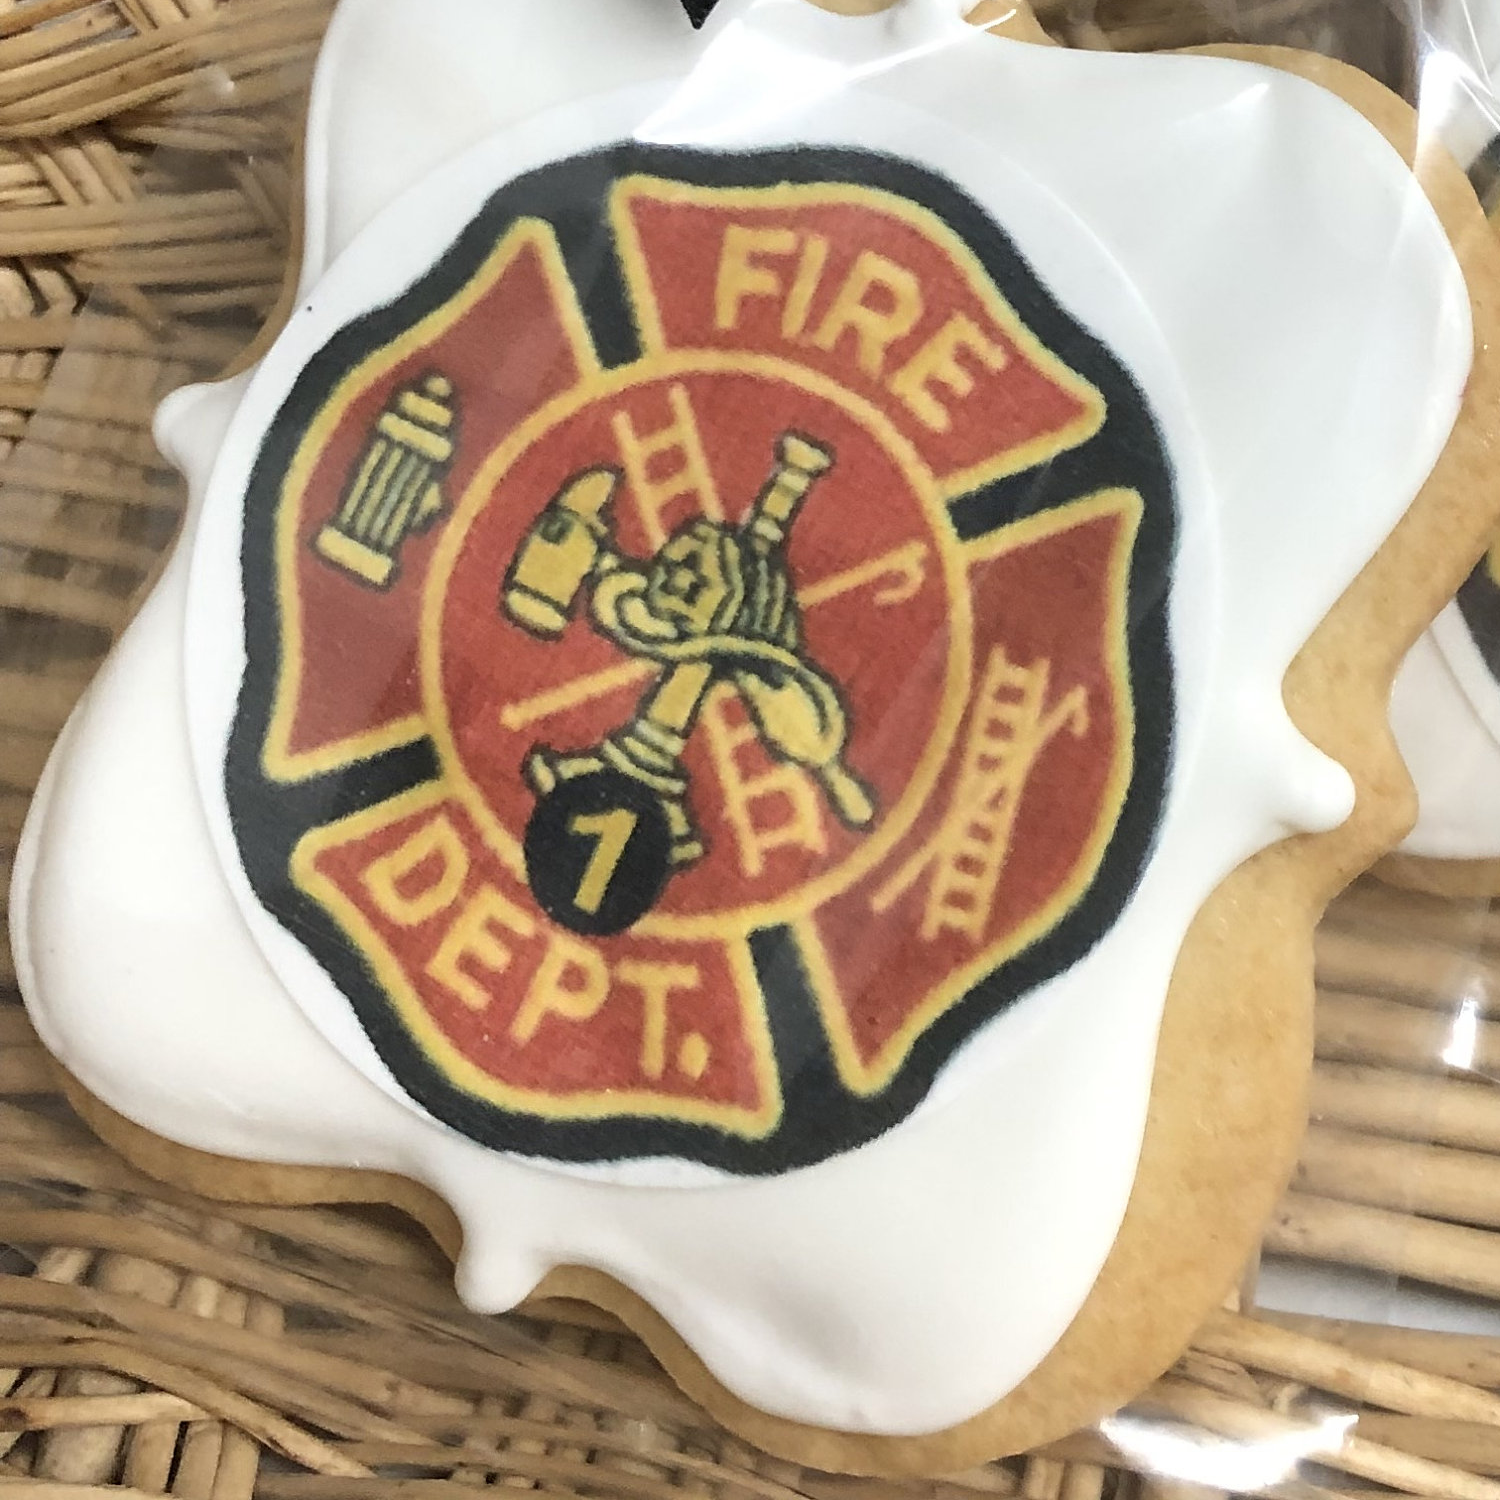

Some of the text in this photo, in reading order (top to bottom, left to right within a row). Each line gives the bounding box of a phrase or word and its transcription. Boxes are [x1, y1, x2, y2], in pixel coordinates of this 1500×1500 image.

[712, 224, 1008, 434] FIRE
[361, 803, 711, 1081] DEPT.
[566, 809, 638, 914] 1
